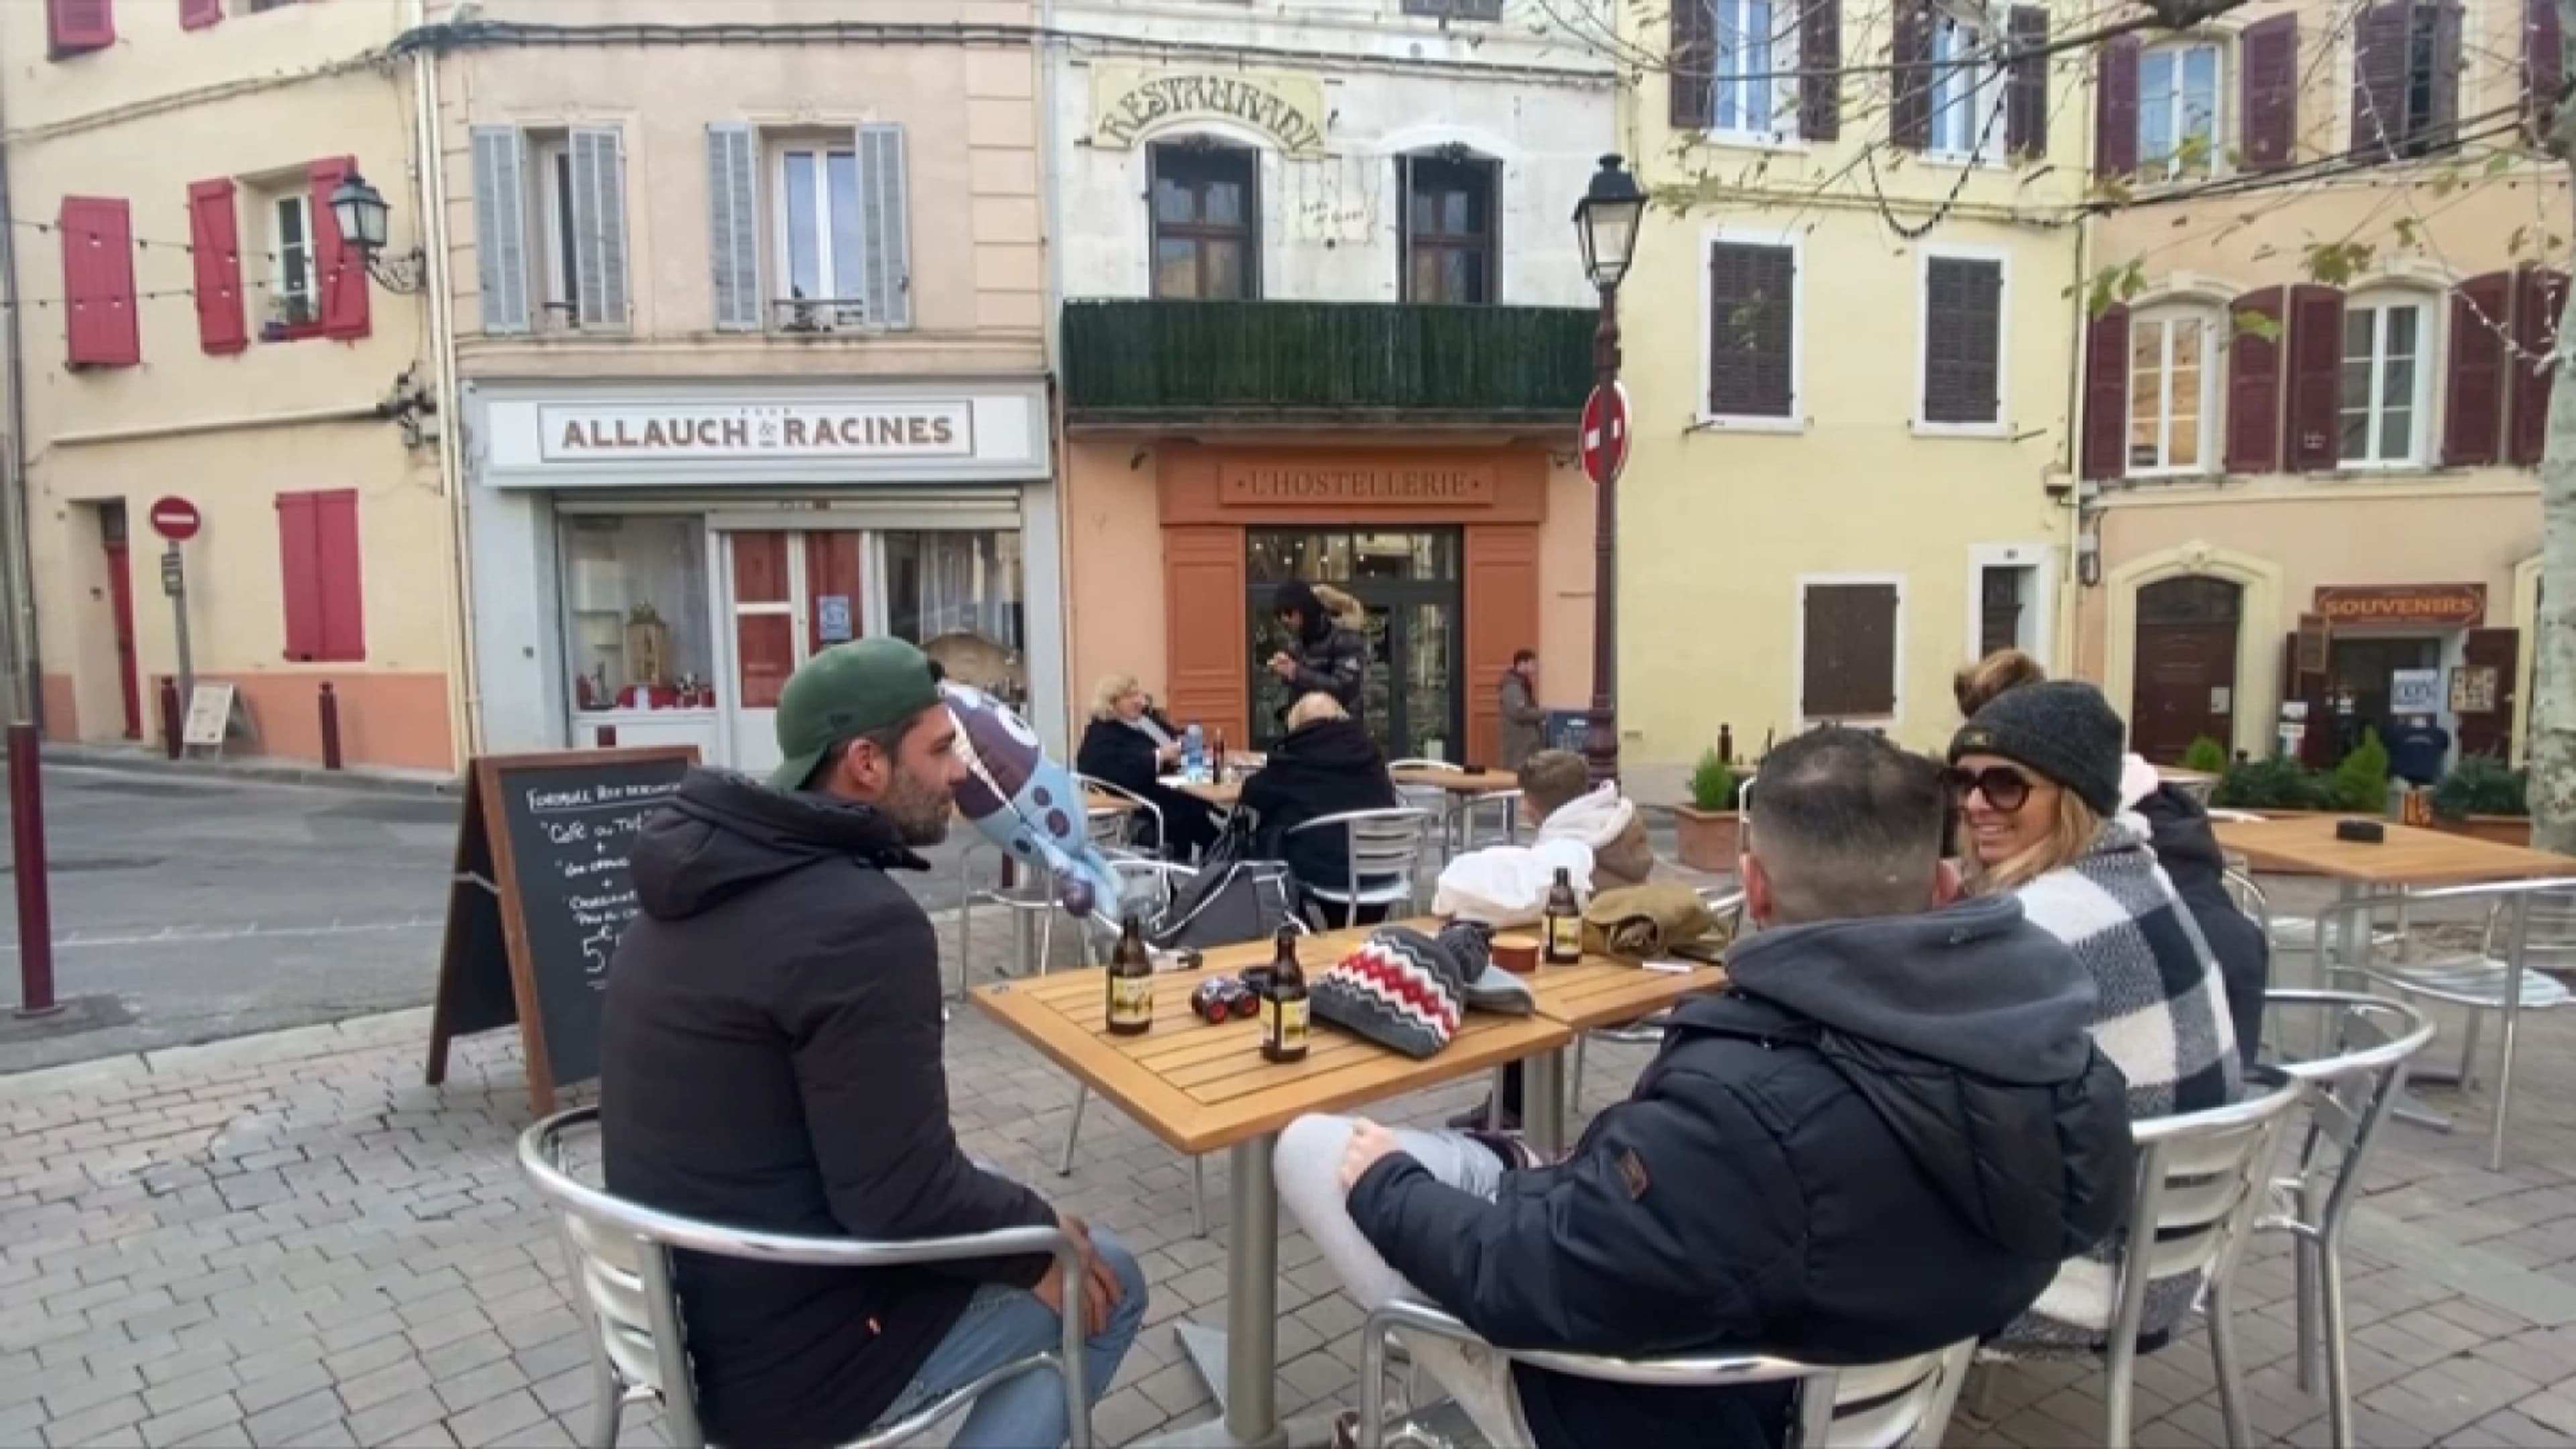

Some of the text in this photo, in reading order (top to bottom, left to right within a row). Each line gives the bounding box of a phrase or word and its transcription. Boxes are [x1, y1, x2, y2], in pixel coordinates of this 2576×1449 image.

[561, 415, 749, 450] ALLAUCH
[784, 415, 953, 445] RACINES
[1252, 472, 1468, 496] L'HOSTELLERIE
[2324, 596, 2475, 615] SOUVENIRS
